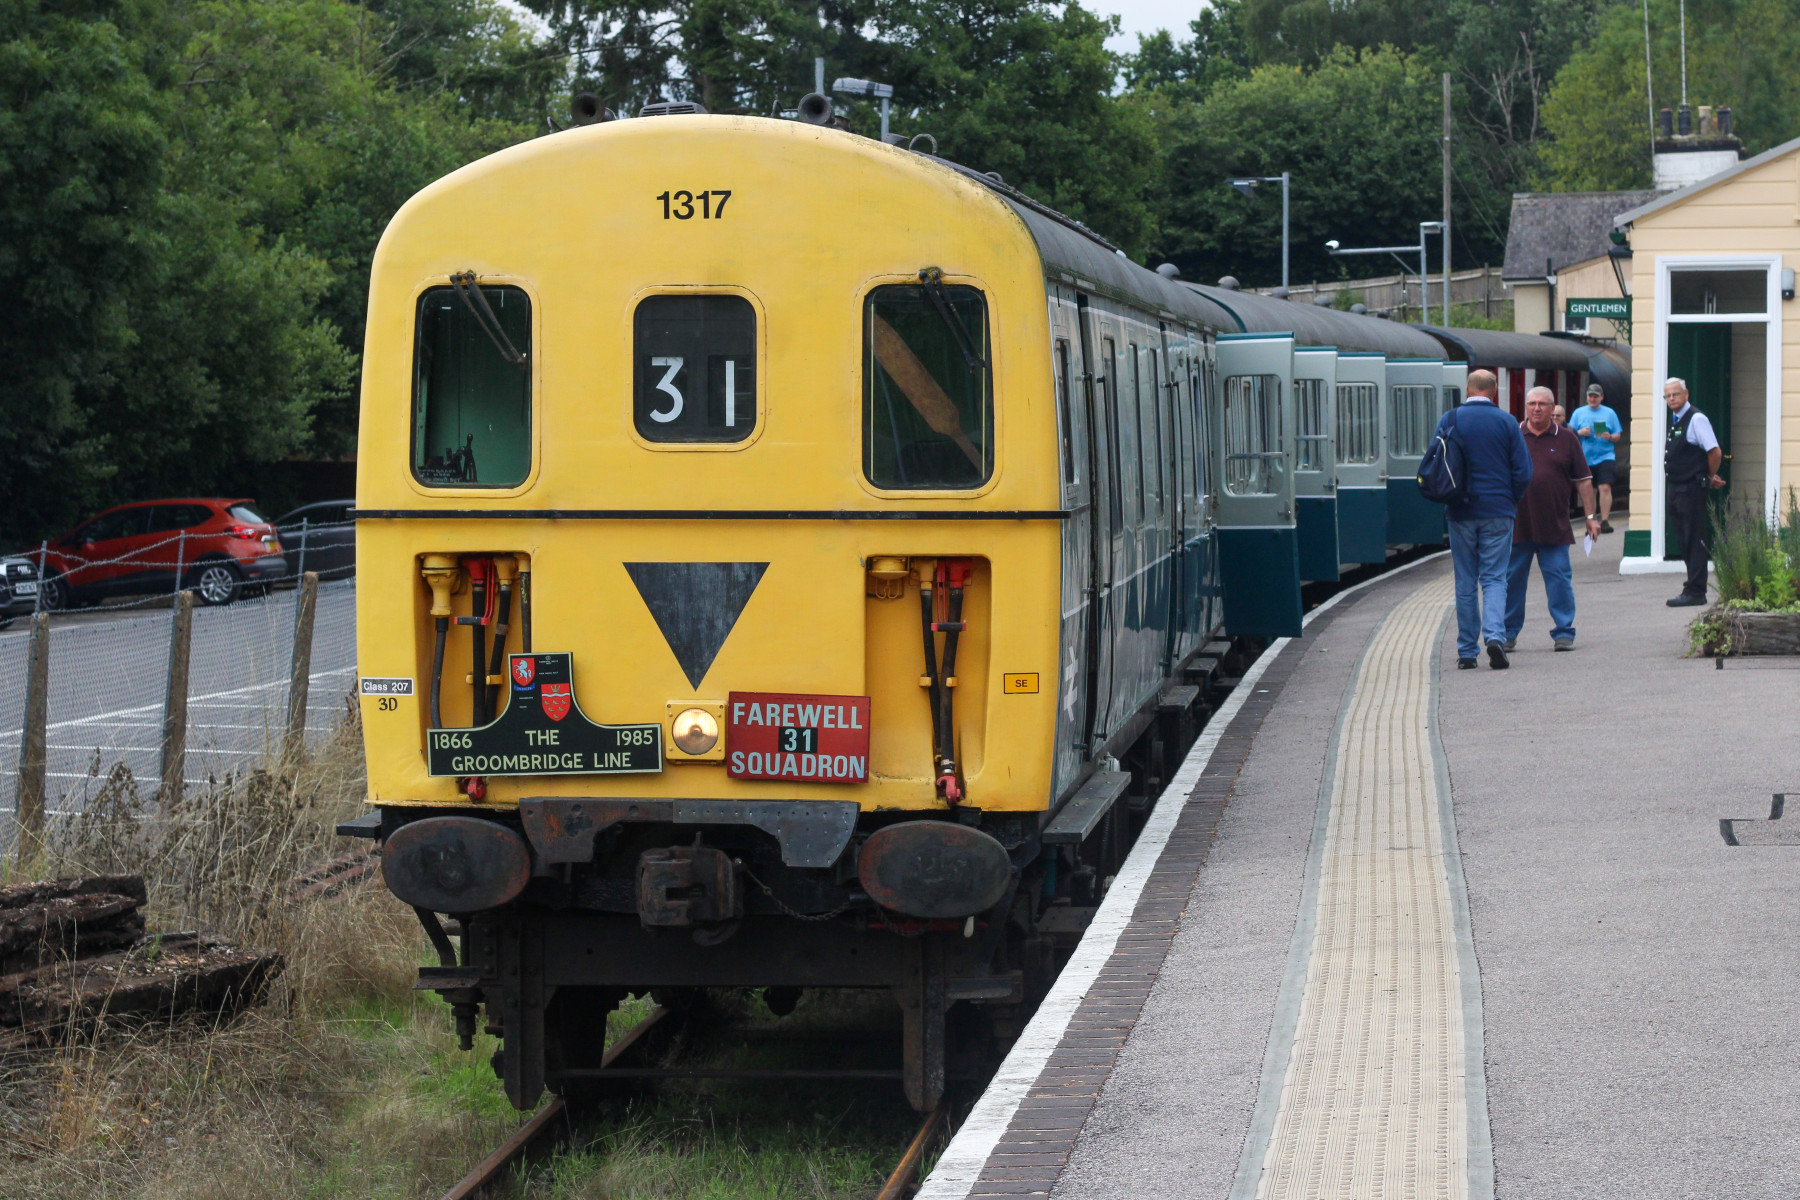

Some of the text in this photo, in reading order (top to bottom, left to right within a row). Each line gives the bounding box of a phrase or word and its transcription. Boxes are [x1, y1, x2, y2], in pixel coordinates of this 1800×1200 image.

[656, 190, 732, 220] 1317
[1570, 303, 1627, 313] GENTLEMEN
[363, 681, 409, 691] Class 207
[1015, 679, 1028, 688] SE
[378, 697, 398, 712] 3D
[733, 702, 863, 730] FAREWELL
[434, 733, 473, 750] 1866
[524, 729, 560, 746] THE
[616, 729, 653, 747] 1985
[784, 728, 811, 752] 31
[451, 752, 632, 772] GROOMBRIDGE LINE
[731, 751, 865, 779] SQUADRON
